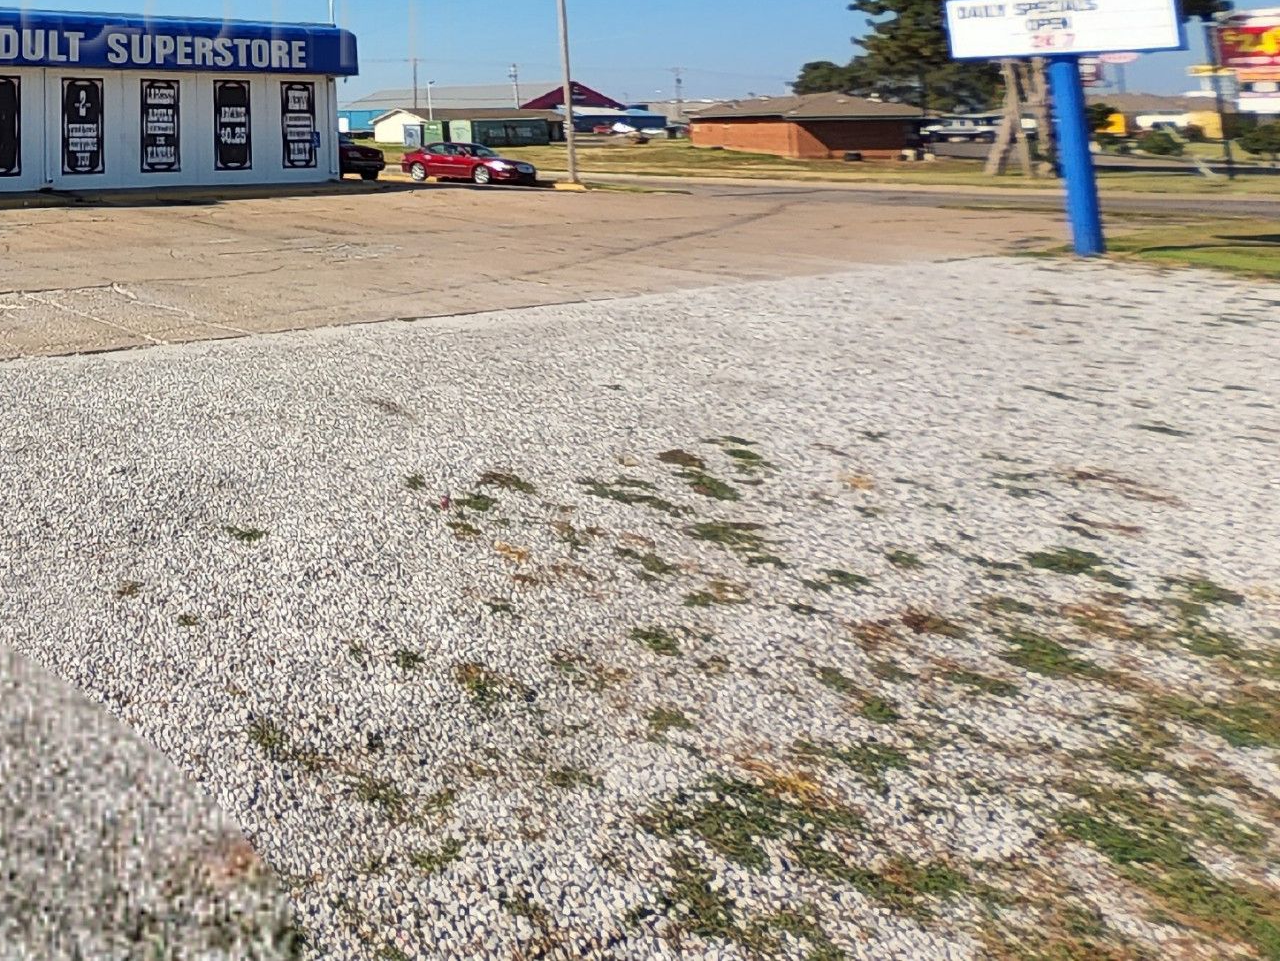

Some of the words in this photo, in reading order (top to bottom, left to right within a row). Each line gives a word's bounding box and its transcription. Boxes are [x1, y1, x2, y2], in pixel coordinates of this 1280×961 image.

[957, 4, 1006, 19] DAILY
[1026, 17, 1073, 31] OPEN
[107, 33, 307, 69] SUPERSTORE
[220, 127, 247, 144] $0.25
